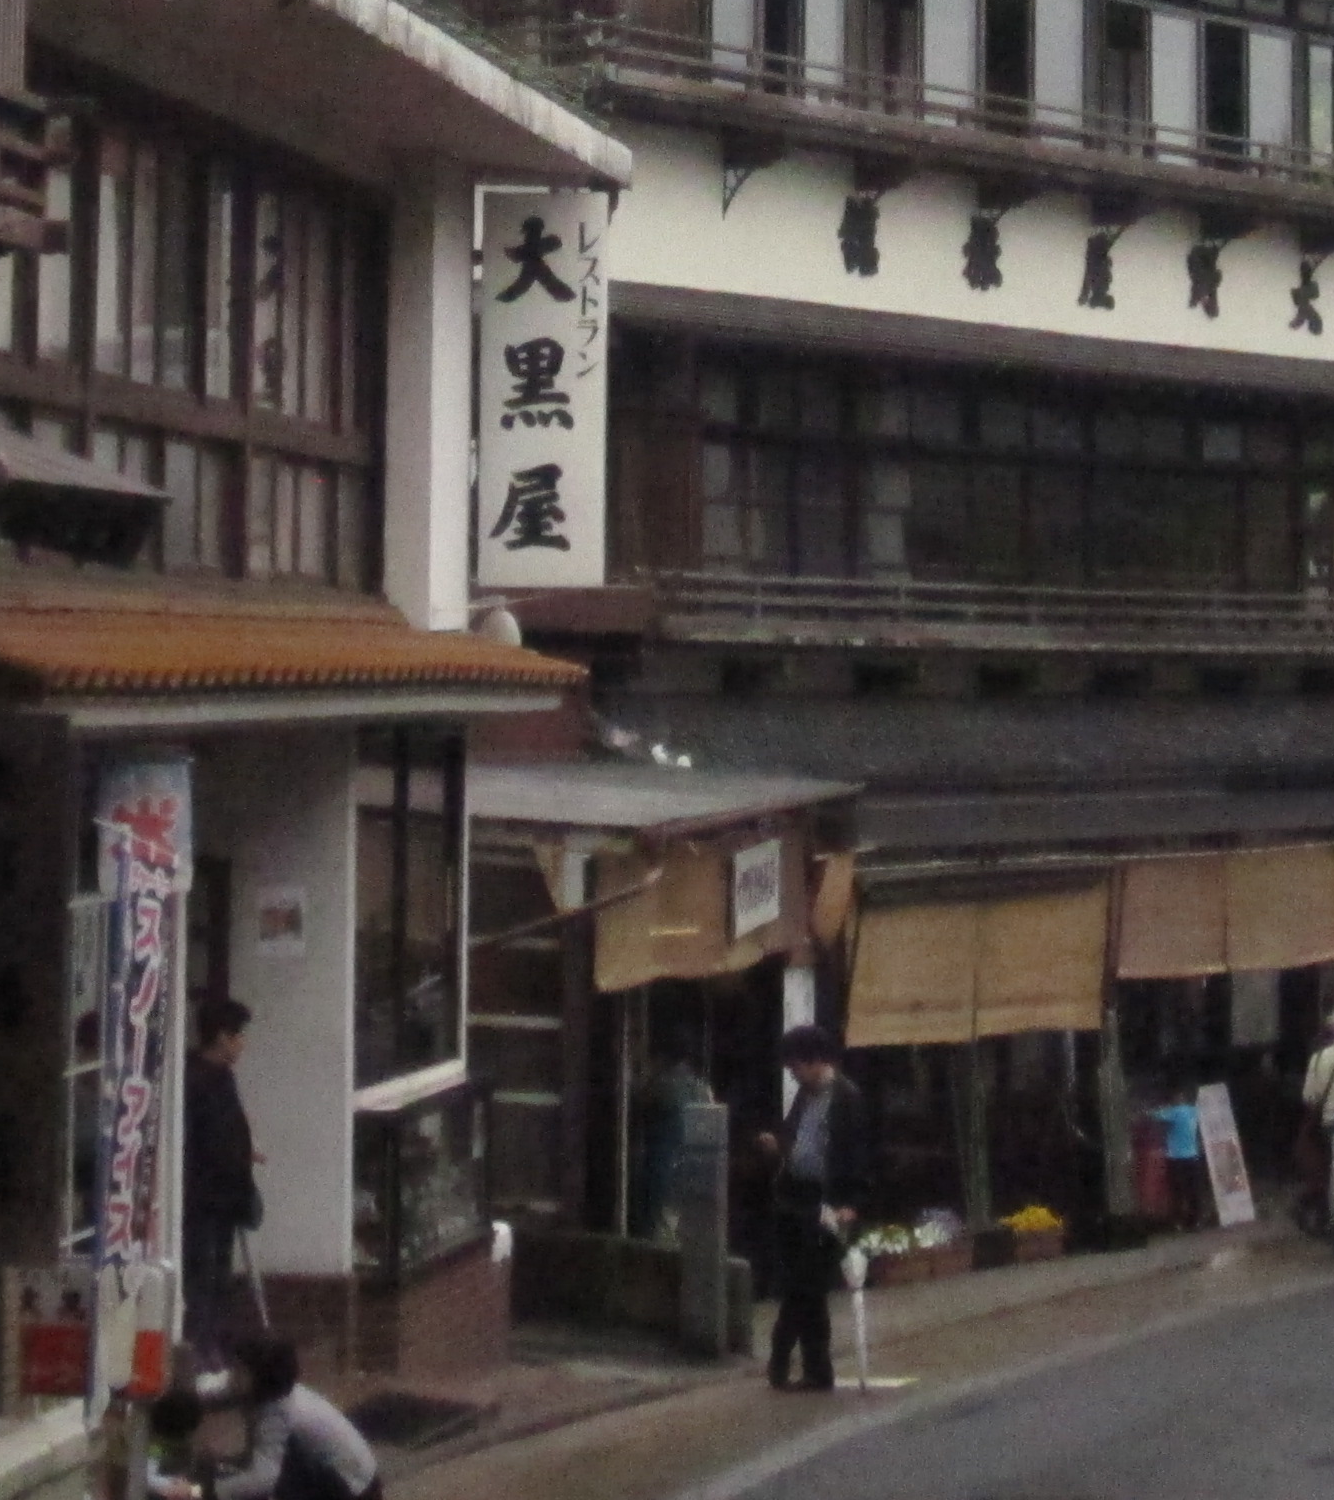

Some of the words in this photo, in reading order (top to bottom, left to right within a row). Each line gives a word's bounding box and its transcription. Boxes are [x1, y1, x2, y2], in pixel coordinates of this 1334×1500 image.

[488, 215, 576, 553] 大黒屋
[575, 219, 602, 378] レストラン
